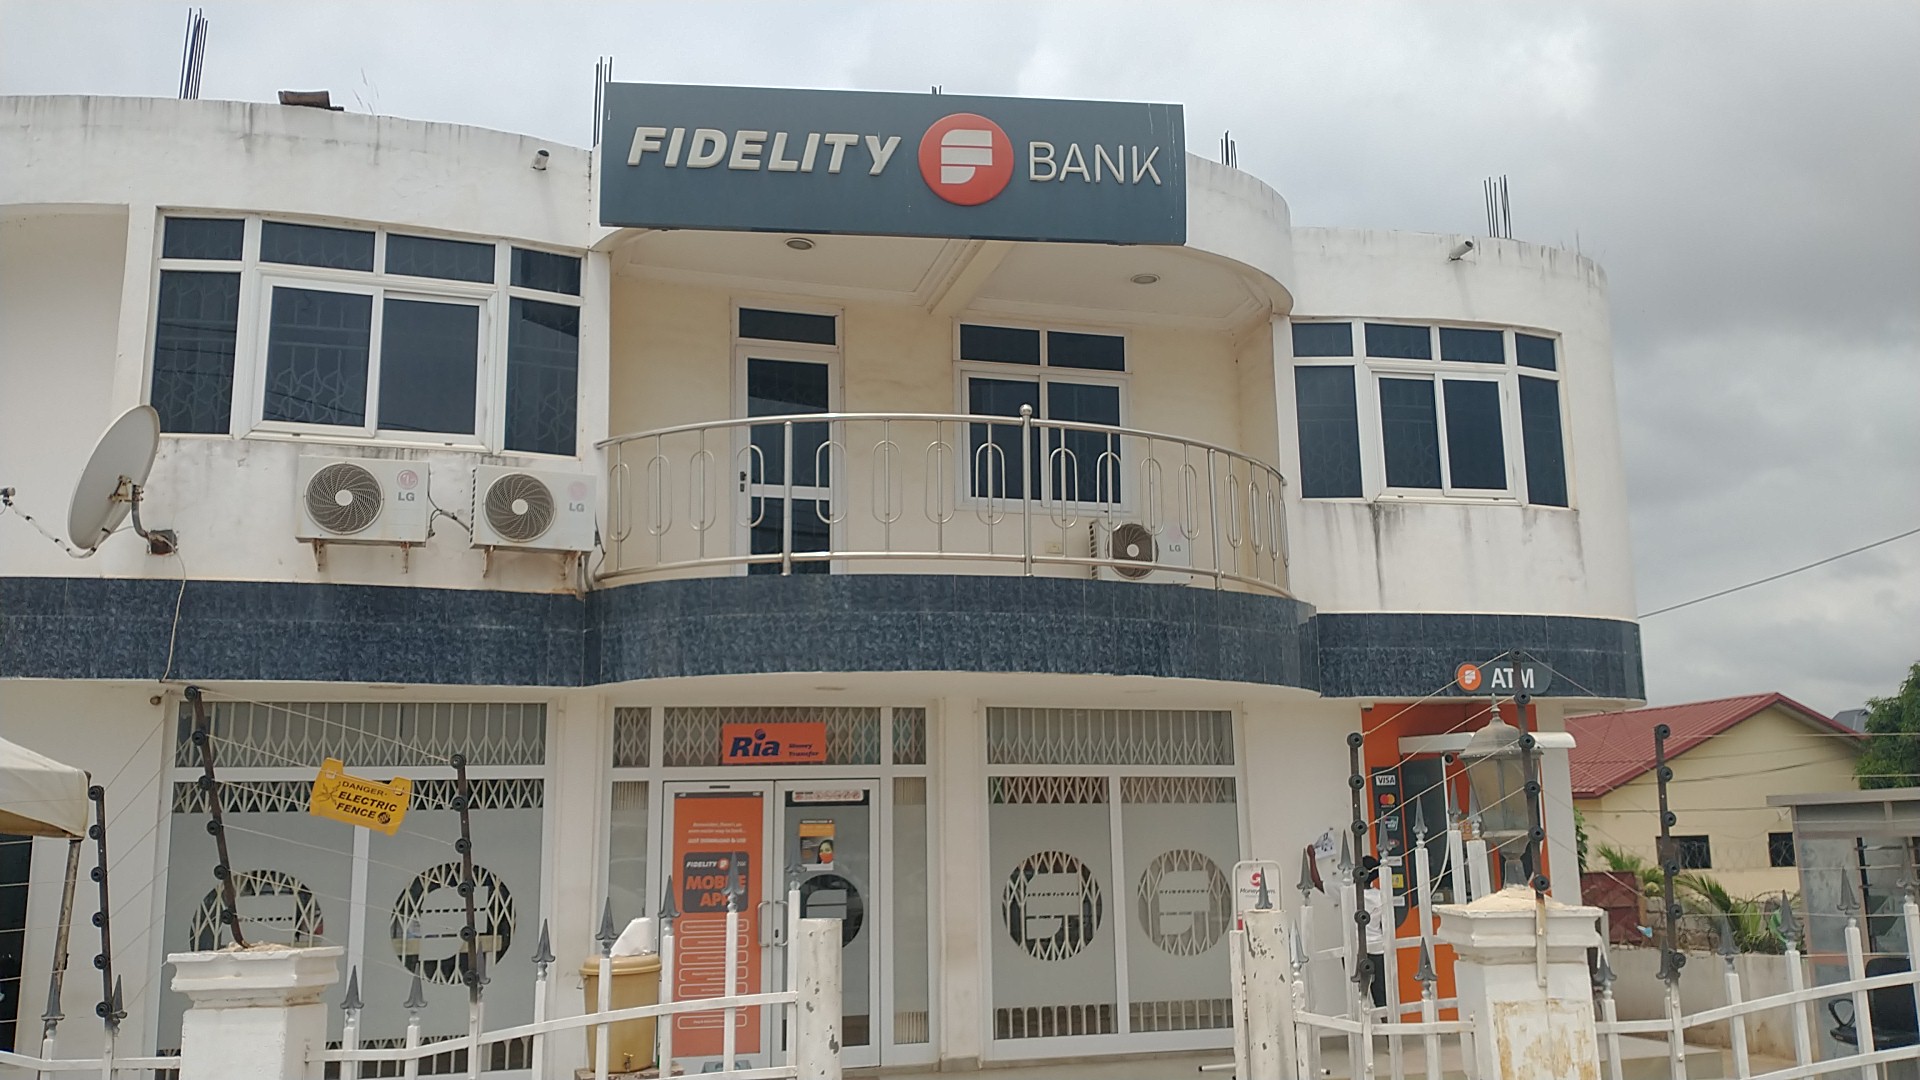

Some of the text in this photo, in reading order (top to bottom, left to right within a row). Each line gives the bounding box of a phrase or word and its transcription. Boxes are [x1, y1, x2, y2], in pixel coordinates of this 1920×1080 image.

[627, 126, 901, 176] FIDELITY
[1028, 141, 1162, 186] BANK
[397, 491, 415, 502] LG
[568, 502, 585, 513] LG
[1169, 544, 1181, 552] LG
[1491, 667, 1535, 689] ATM
[729, 729, 780, 757] Ria
[1377, 776, 1395, 785] VISA
[338, 790, 398, 813] ELECTRIC
[336, 803, 376, 819] FENCE
[685, 874, 746, 890] MOBIE
